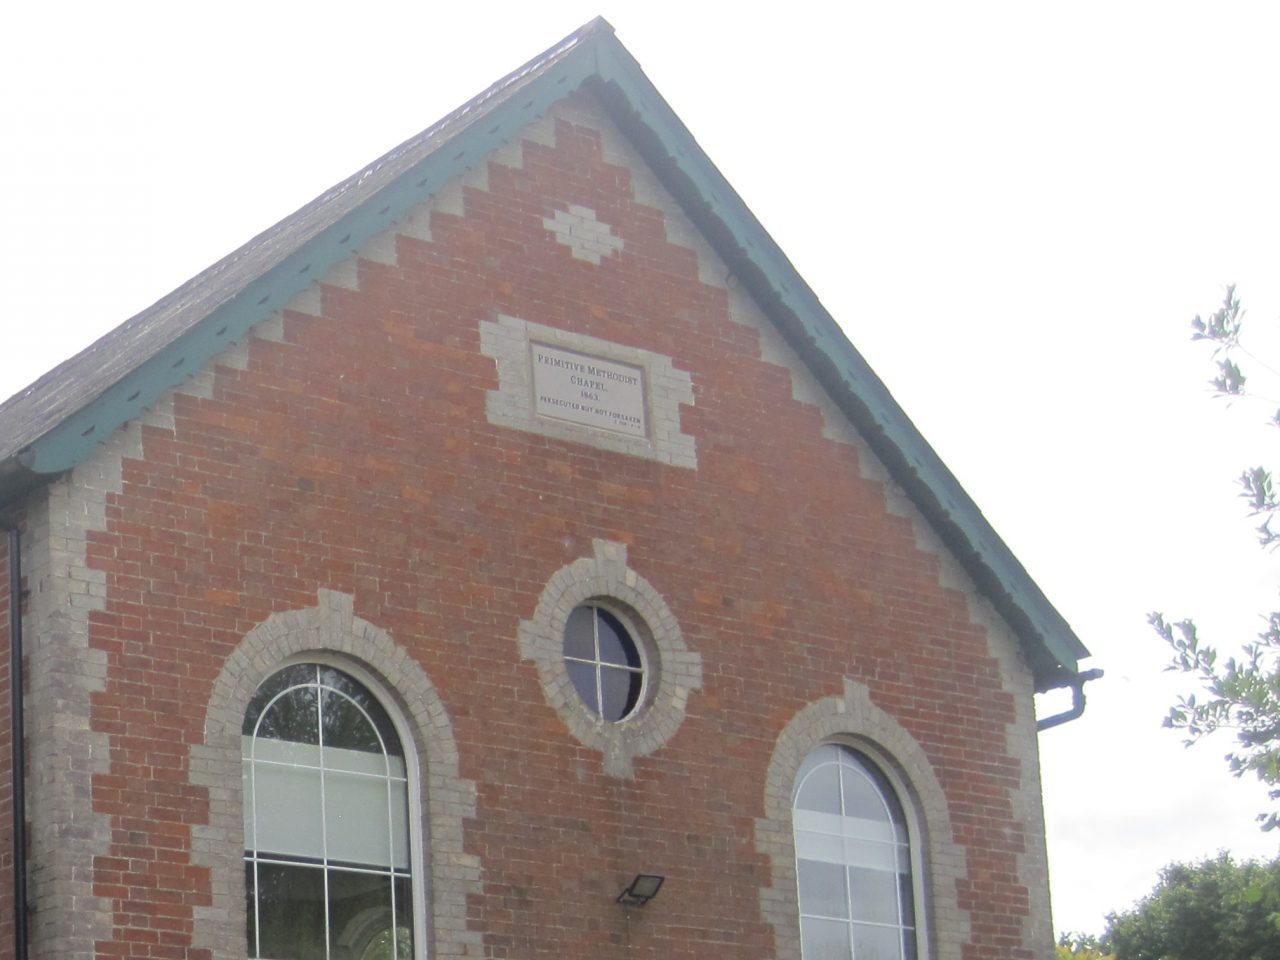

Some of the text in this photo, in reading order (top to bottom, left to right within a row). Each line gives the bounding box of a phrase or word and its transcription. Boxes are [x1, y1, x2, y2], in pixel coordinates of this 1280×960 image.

[538, 354, 637, 385] PRIMITIVE METHODIST
[540, 396, 579, 410] PERSECUTED
[581, 404, 593, 413] BUT
[595, 407, 607, 416] NOT
[609, 411, 640, 424] FORSAKEN
